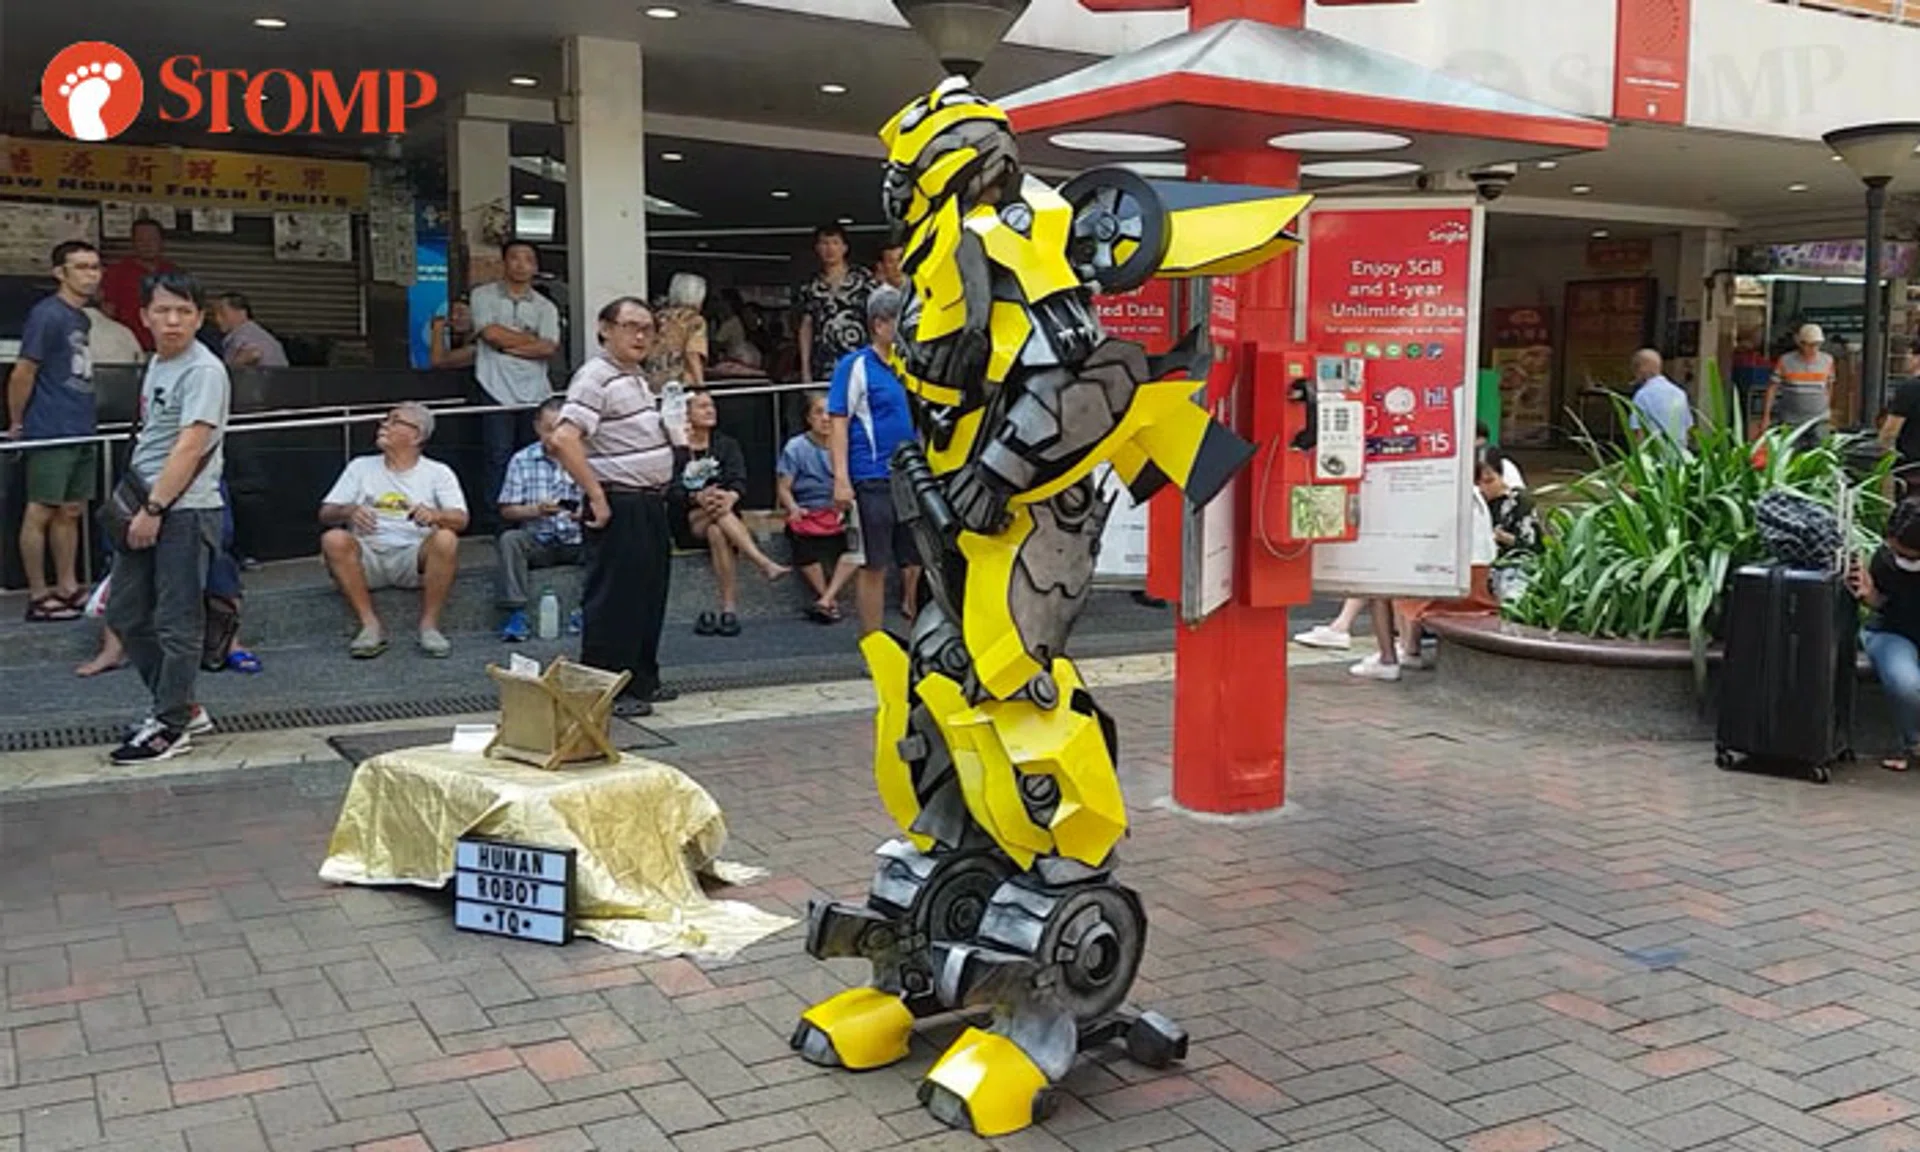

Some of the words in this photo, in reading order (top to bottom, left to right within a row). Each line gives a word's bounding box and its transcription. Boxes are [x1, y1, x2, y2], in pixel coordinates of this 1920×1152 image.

[1351, 260, 1402, 278] Enjoy
[1406, 259, 1443, 275] 3GB
[1348, 282, 1384, 296] and
[1388, 282, 1444, 299] 1-year
[1126, 304, 1165, 317] Data
[1331, 303, 1420, 317] Unlimited
[1423, 303, 1466, 317] Data
[478, 845, 544, 876] HUMAN
[477, 875, 539, 905] ROBOT
